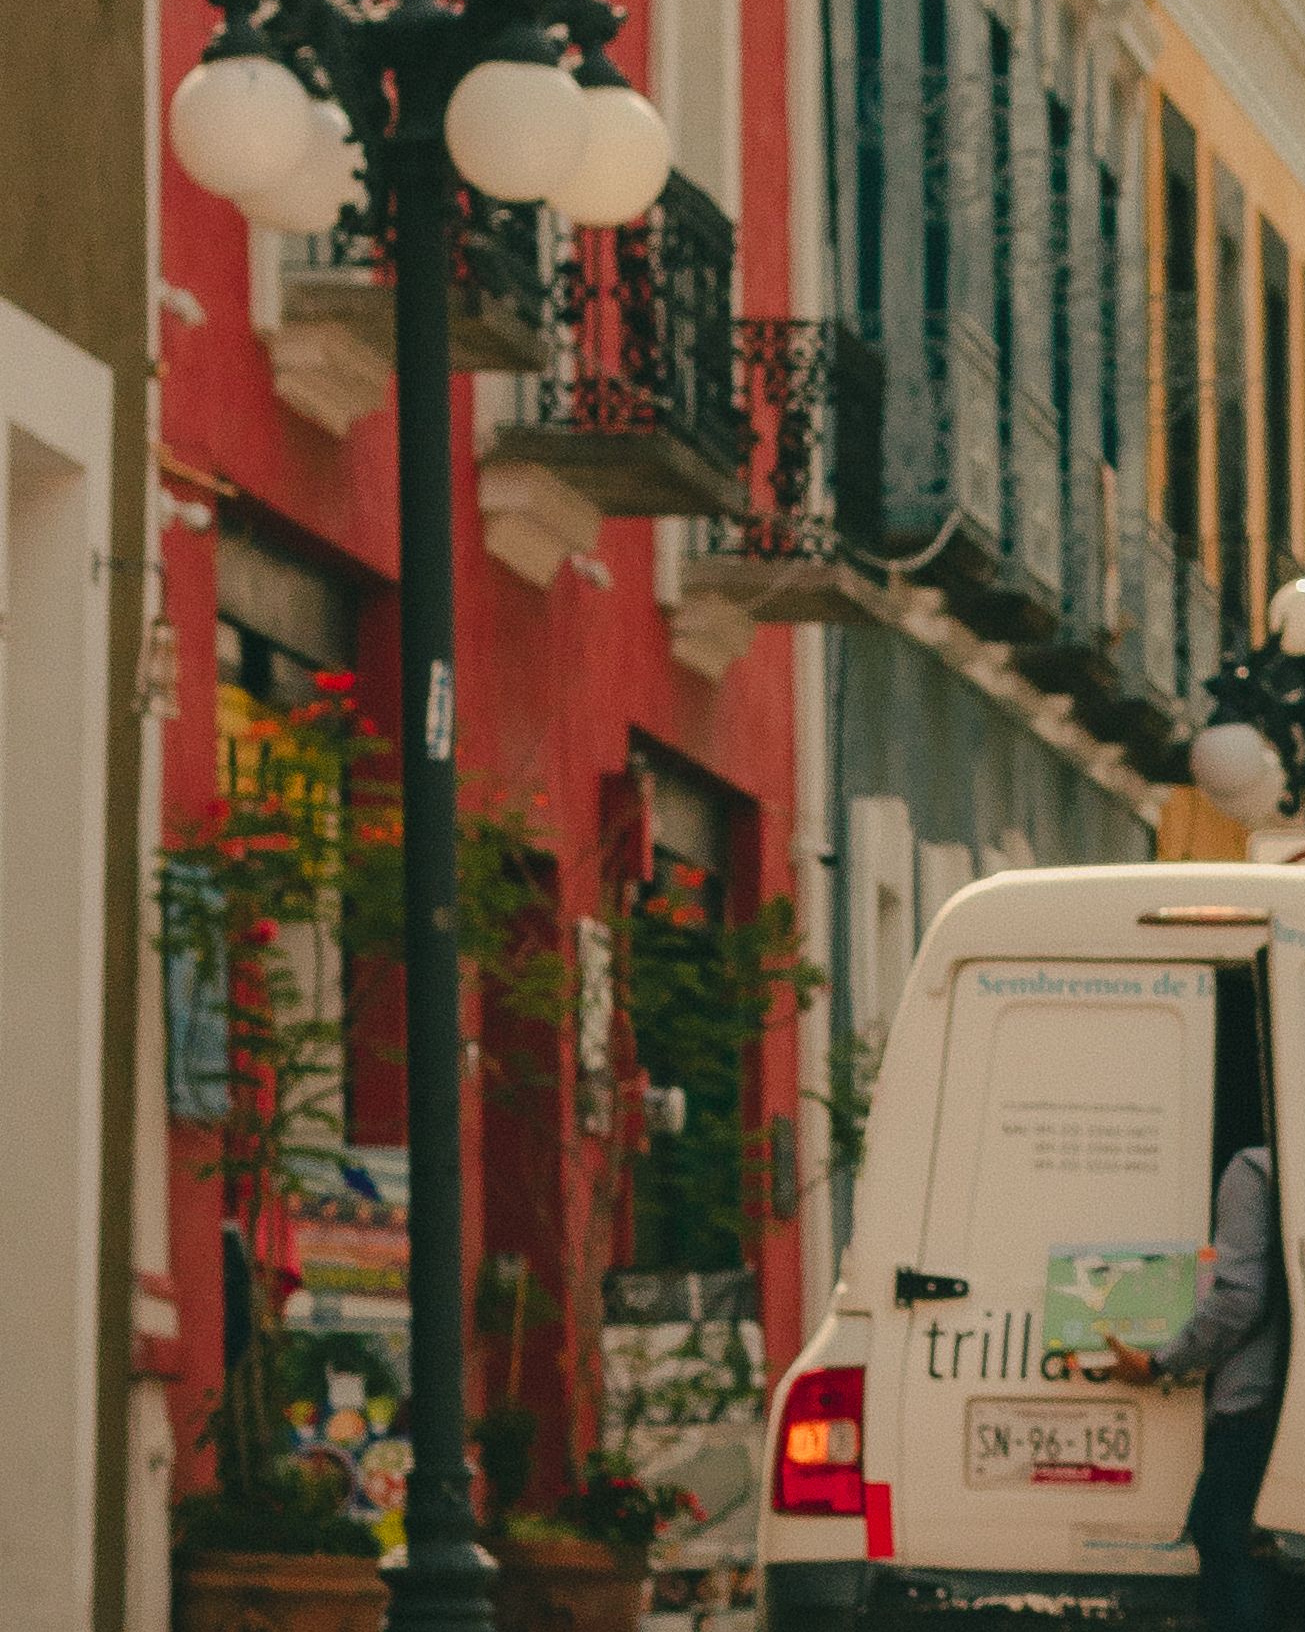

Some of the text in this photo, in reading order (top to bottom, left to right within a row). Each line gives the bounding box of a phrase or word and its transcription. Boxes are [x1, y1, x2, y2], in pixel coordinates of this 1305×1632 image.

[977, 969, 1143, 996] Sembremos
[1152, 970, 1187, 997] de
[977, 1423, 1132, 1463] SN-96-150
